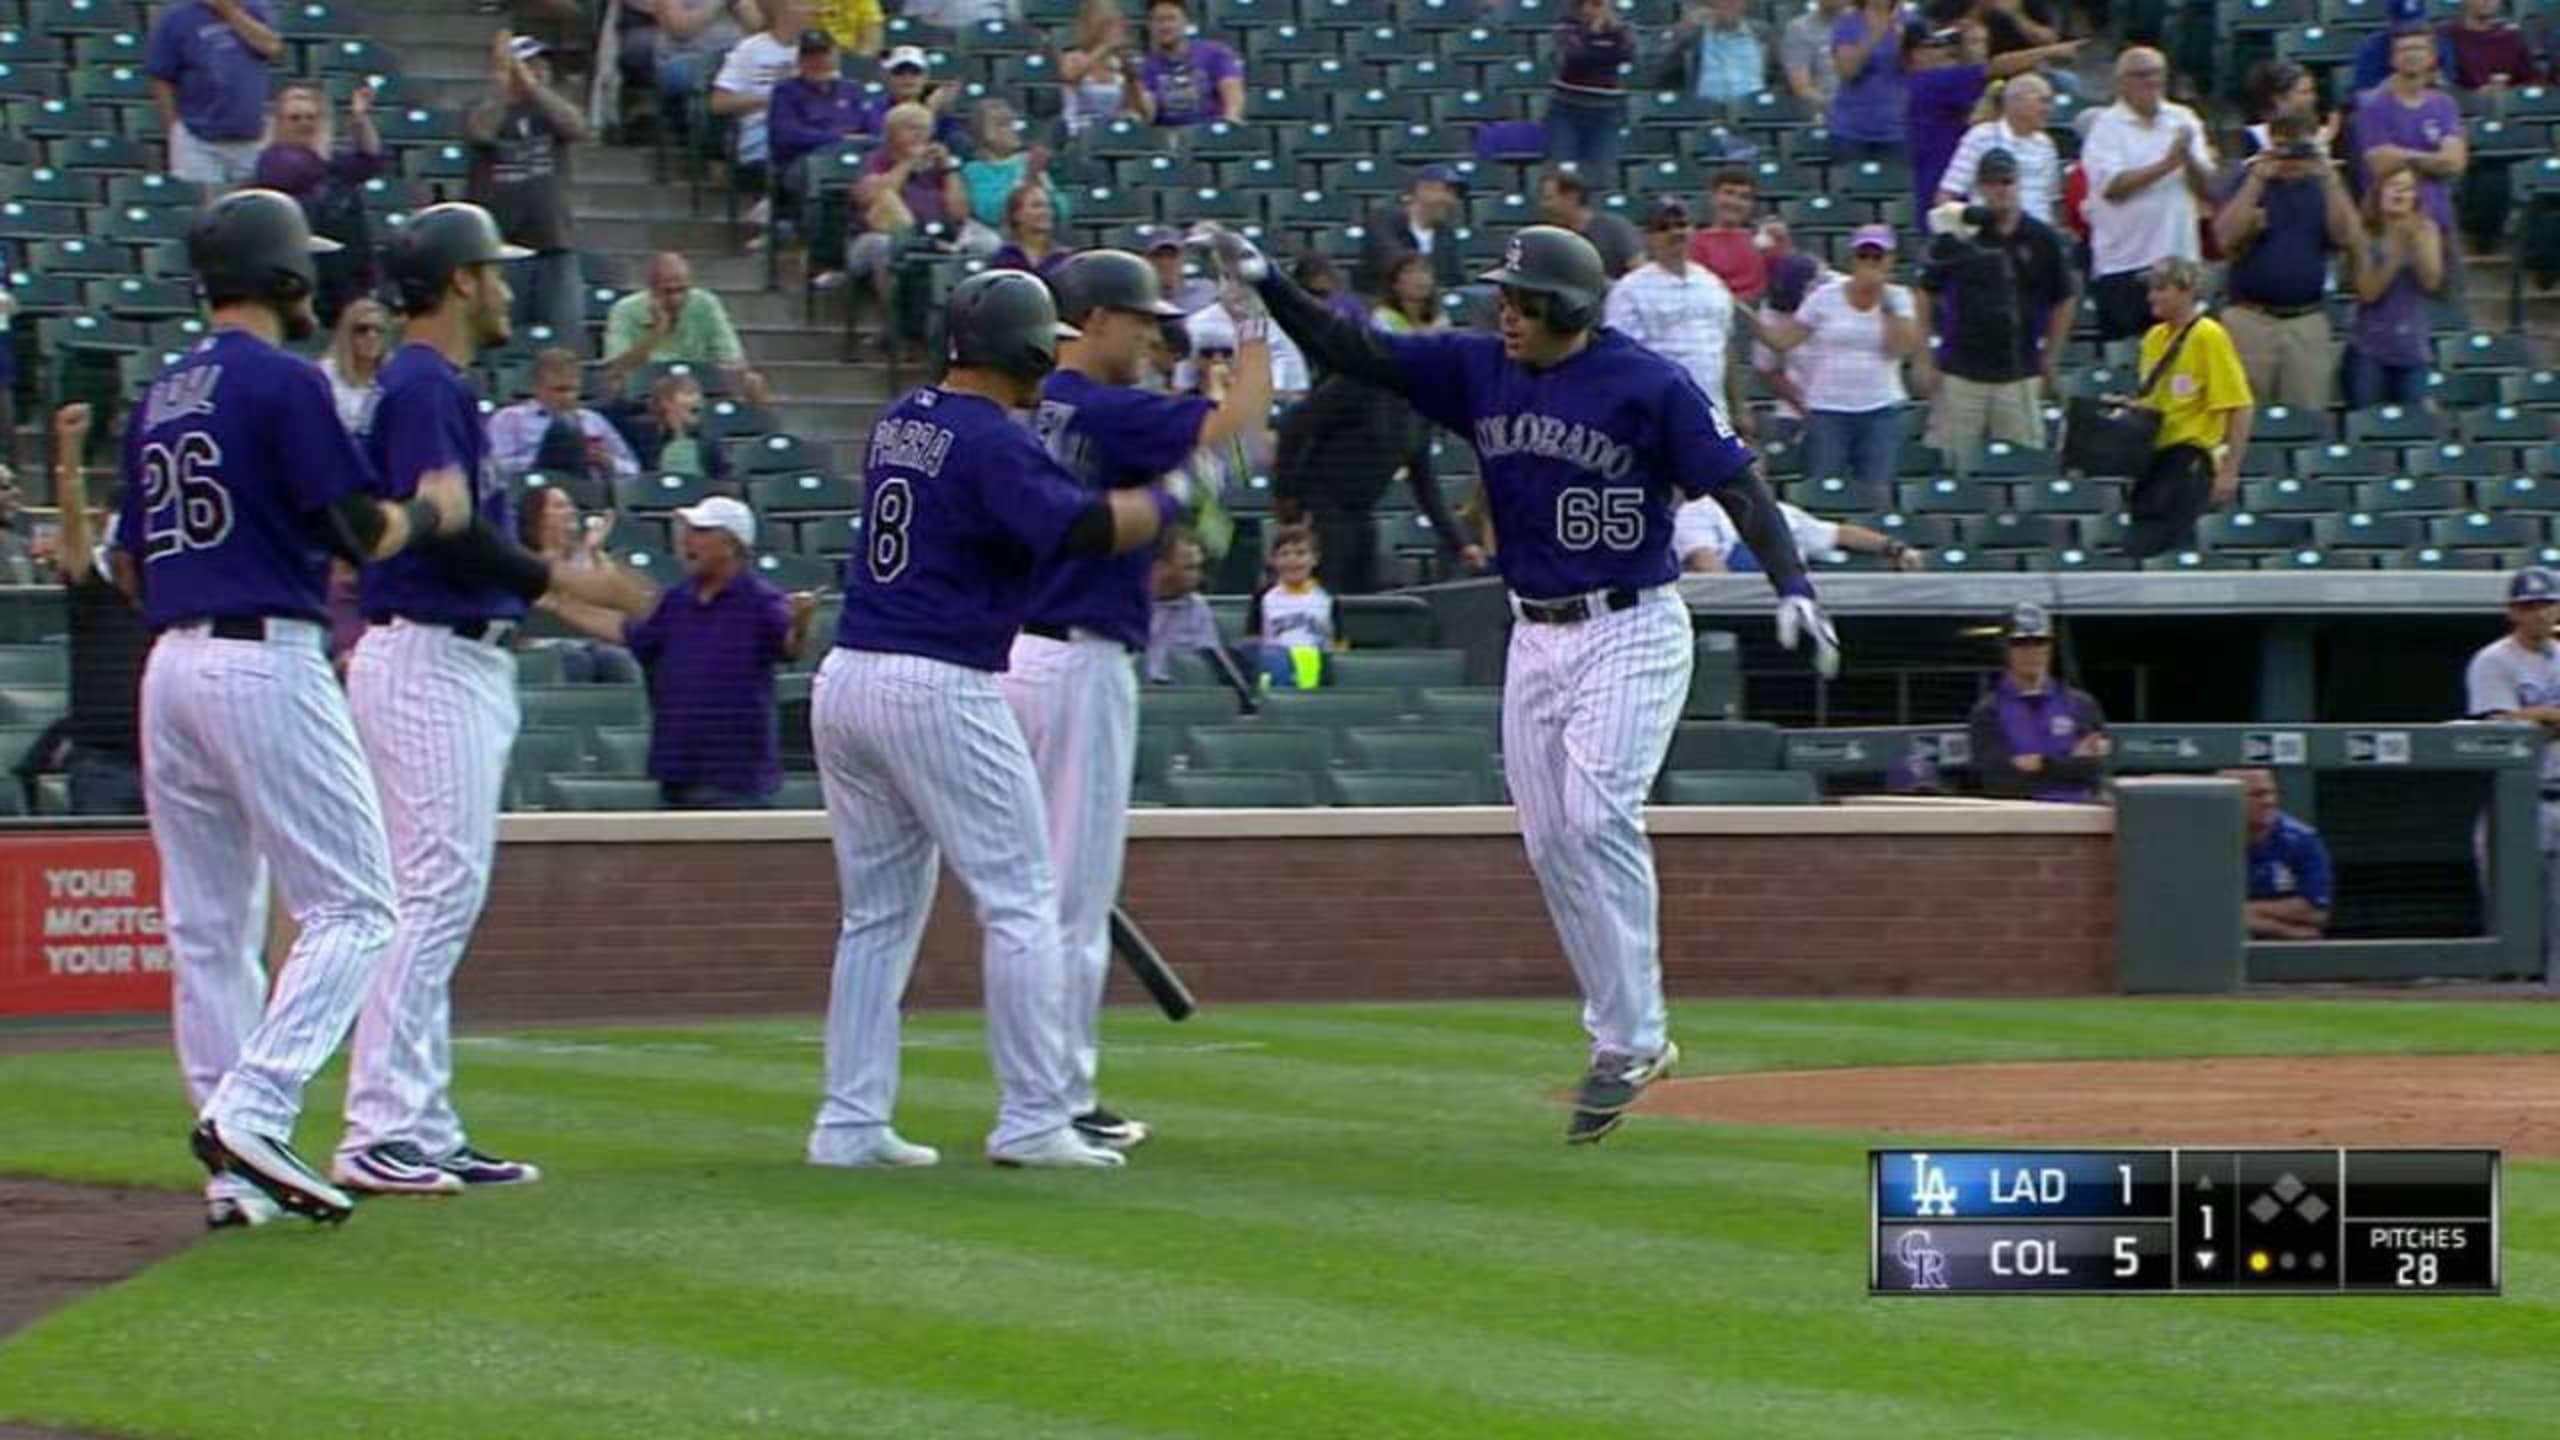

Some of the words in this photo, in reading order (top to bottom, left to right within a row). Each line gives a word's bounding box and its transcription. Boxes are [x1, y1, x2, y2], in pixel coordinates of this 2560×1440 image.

[143, 431, 233, 562] 26
[1557, 487, 1645, 550] 65
[868, 477, 913, 583] 8
[44, 868, 135, 899] YOUR
[44, 907, 168, 935] MORTG
[44, 946, 135, 974] YOUR
[140, 946, 174, 974] W
